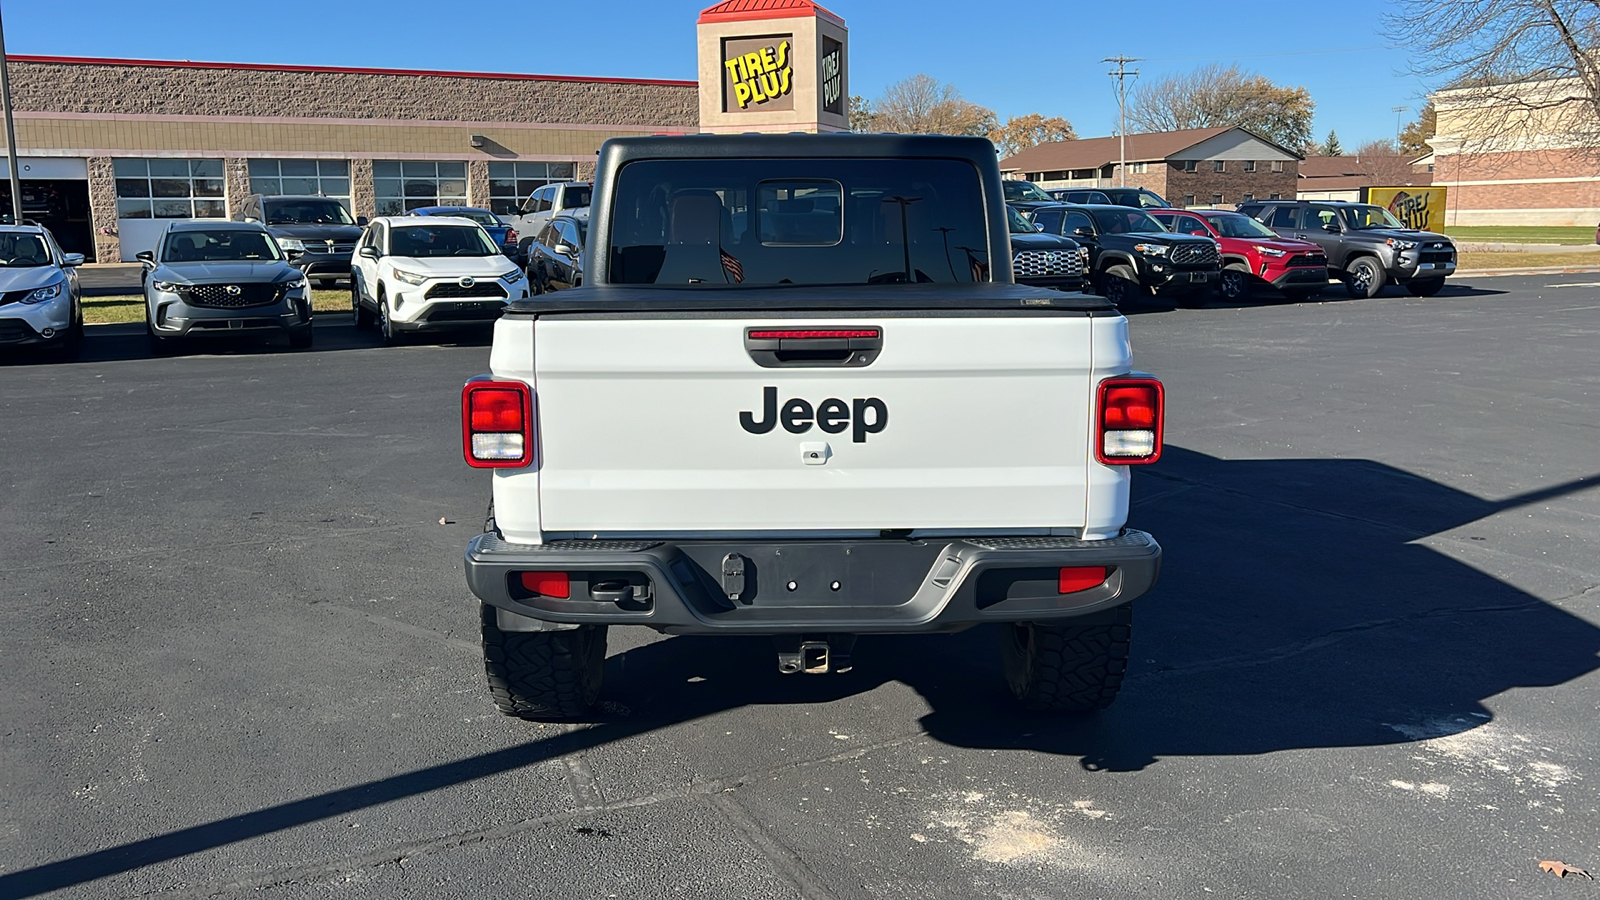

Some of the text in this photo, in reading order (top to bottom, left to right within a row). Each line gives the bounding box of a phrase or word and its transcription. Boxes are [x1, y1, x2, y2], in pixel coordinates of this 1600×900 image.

[725, 40, 790, 84] TIRES
[822, 49, 840, 82] TIRES
[734, 66, 792, 108] PLUS
[824, 74, 841, 107] PLUS
[1396, 191, 1430, 219] TIRES
[739, 386, 888, 443] Jeep
